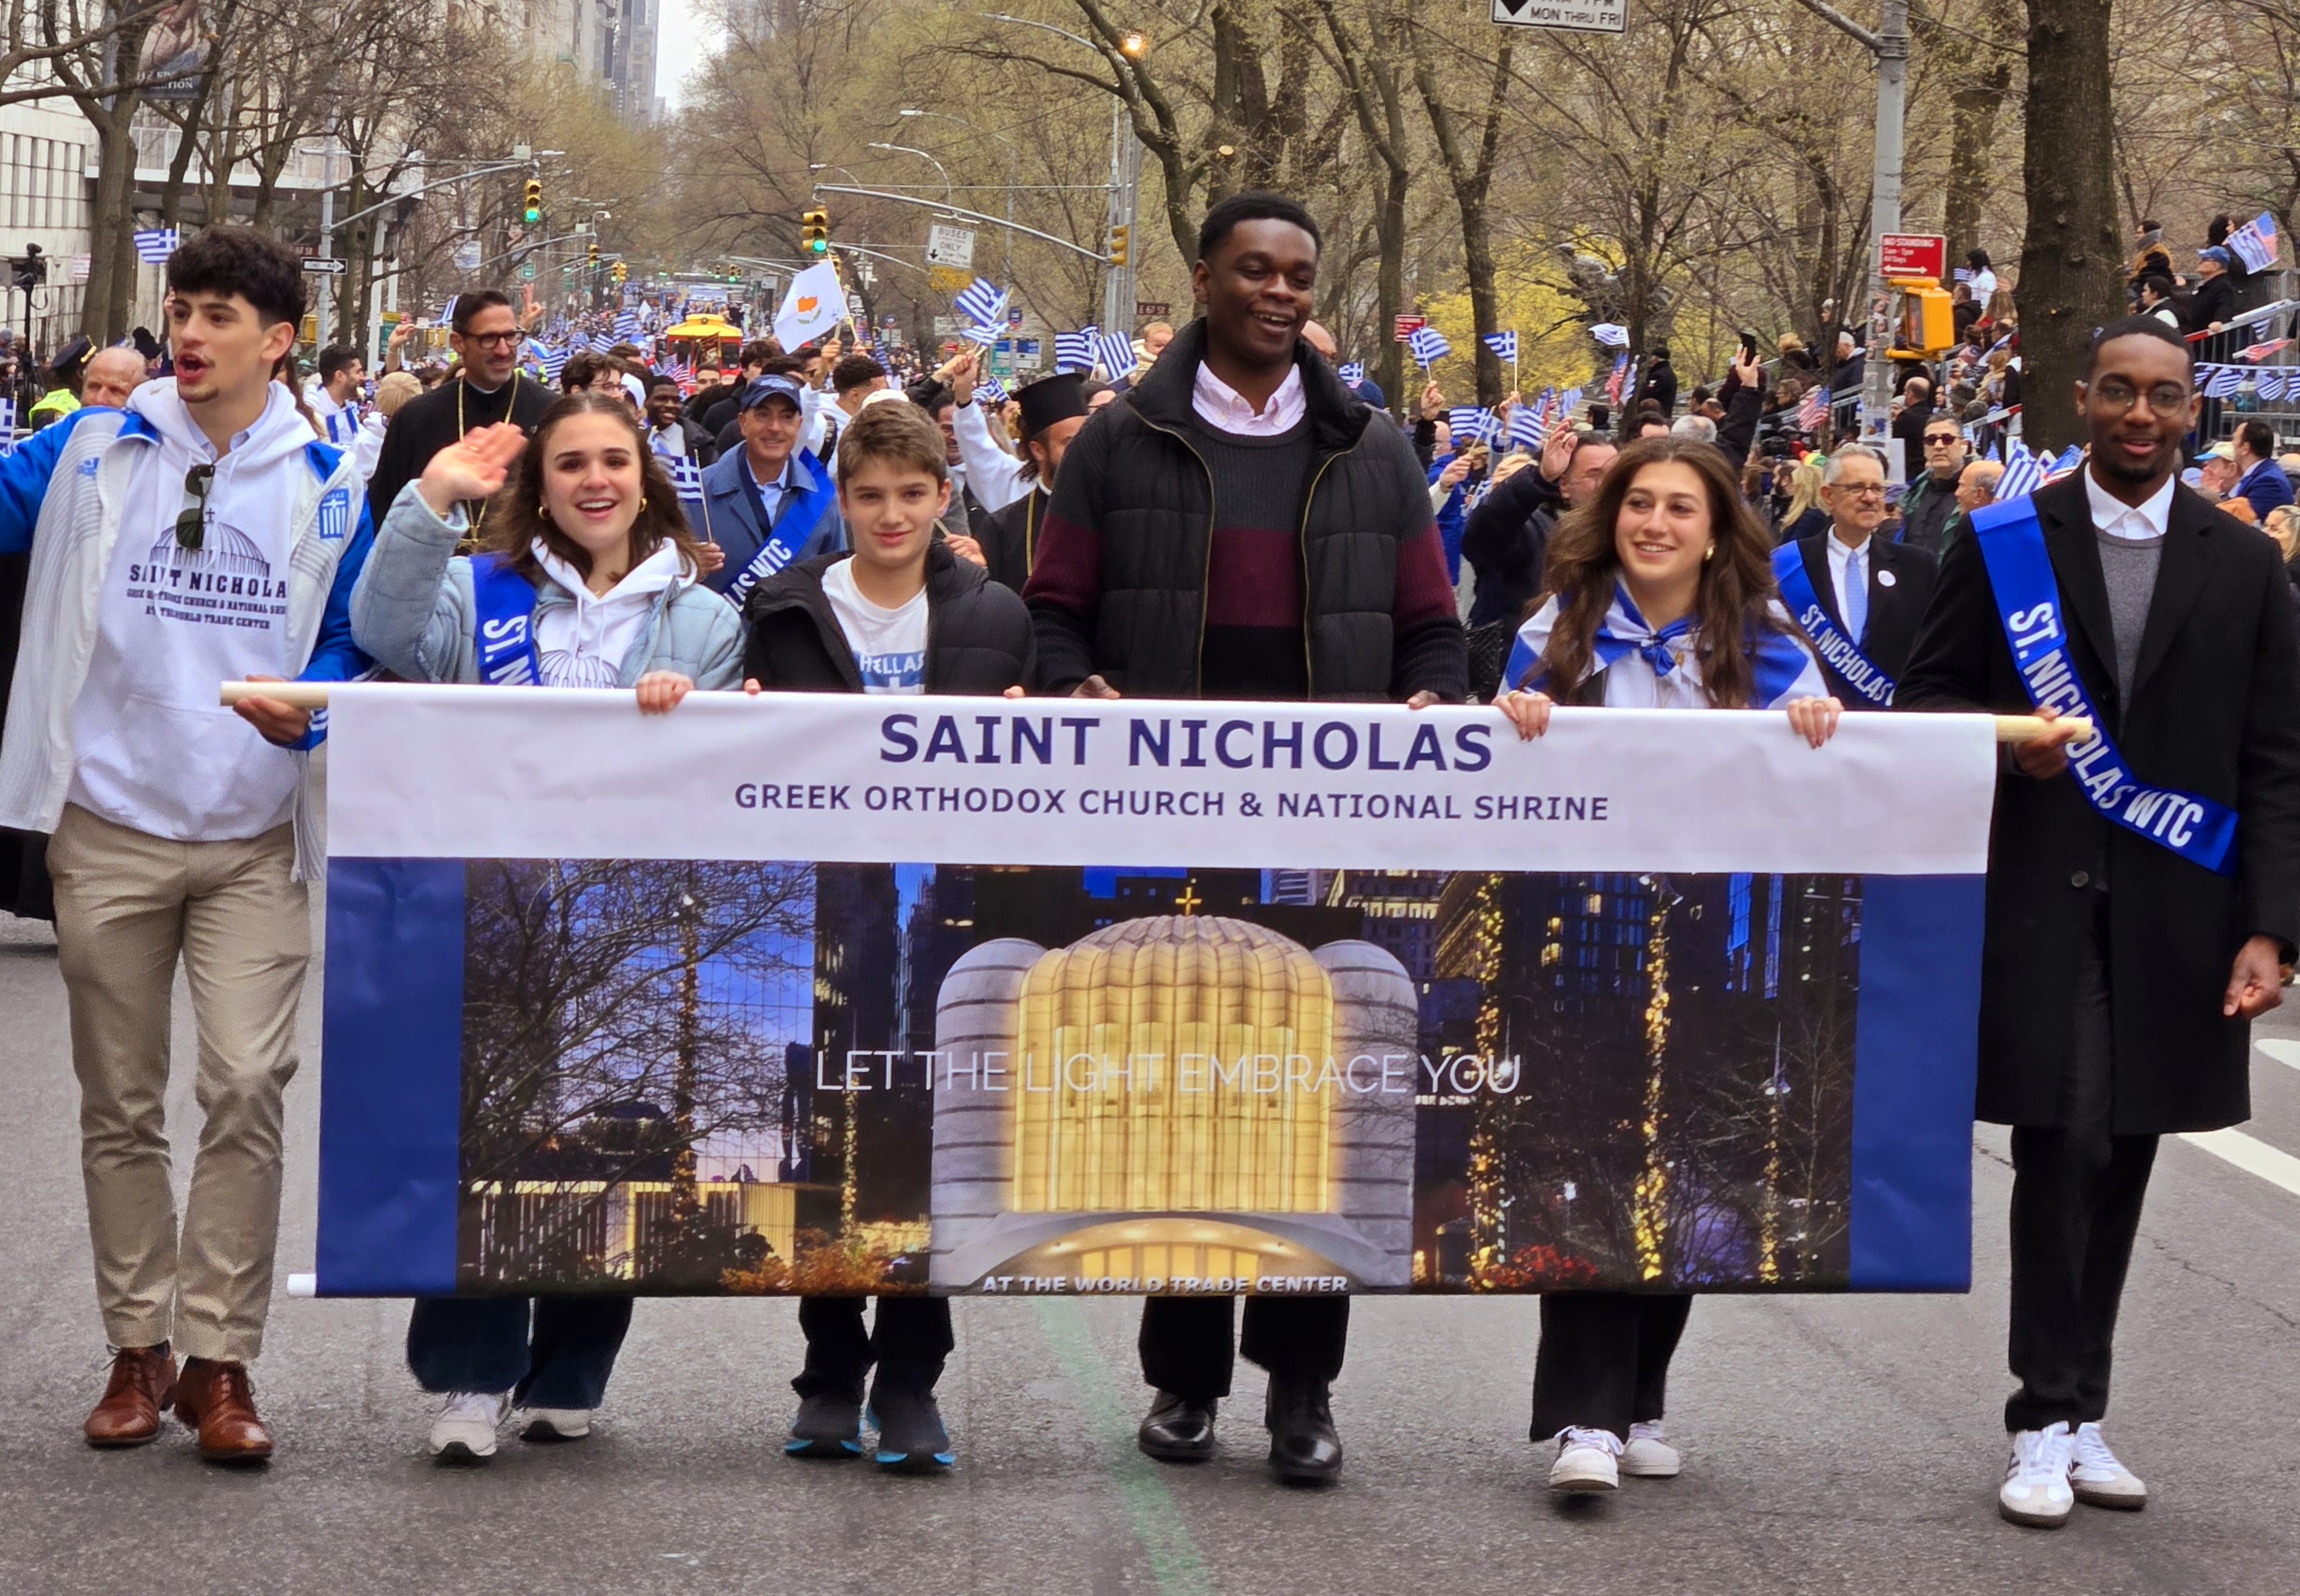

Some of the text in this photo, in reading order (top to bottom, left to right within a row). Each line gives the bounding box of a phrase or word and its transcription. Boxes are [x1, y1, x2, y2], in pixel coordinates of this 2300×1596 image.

[1530, 7, 1621, 26] MON THRU FRI
[938, 227, 967, 239] BUSES
[940, 241, 961, 251] ONLY
[747, 538, 792, 578] WTC
[189, 571, 286, 598] NICHOLA
[204, 614, 234, 626] TRADE
[236, 617, 270, 629] CENTER
[227, 600, 268, 613] NATIONAL
[483, 615, 528, 663] ST.
[1800, 604, 1894, 701] ST. NICHOLAS
[2008, 602, 2059, 660] ST.
[2123, 789, 2203, 847] WTC
[879, 713, 1493, 772] SAINT NICHOLAS
[735, 783, 1609, 821] GREEK ORTHODOX CHURCH & NATIONAL SHRINE
[817, 1050, 1521, 1094] LET THE LIGHT EMBRACE YOU
[983, 1276, 1348, 1292] AT THE WORLD TRADE CENTER
